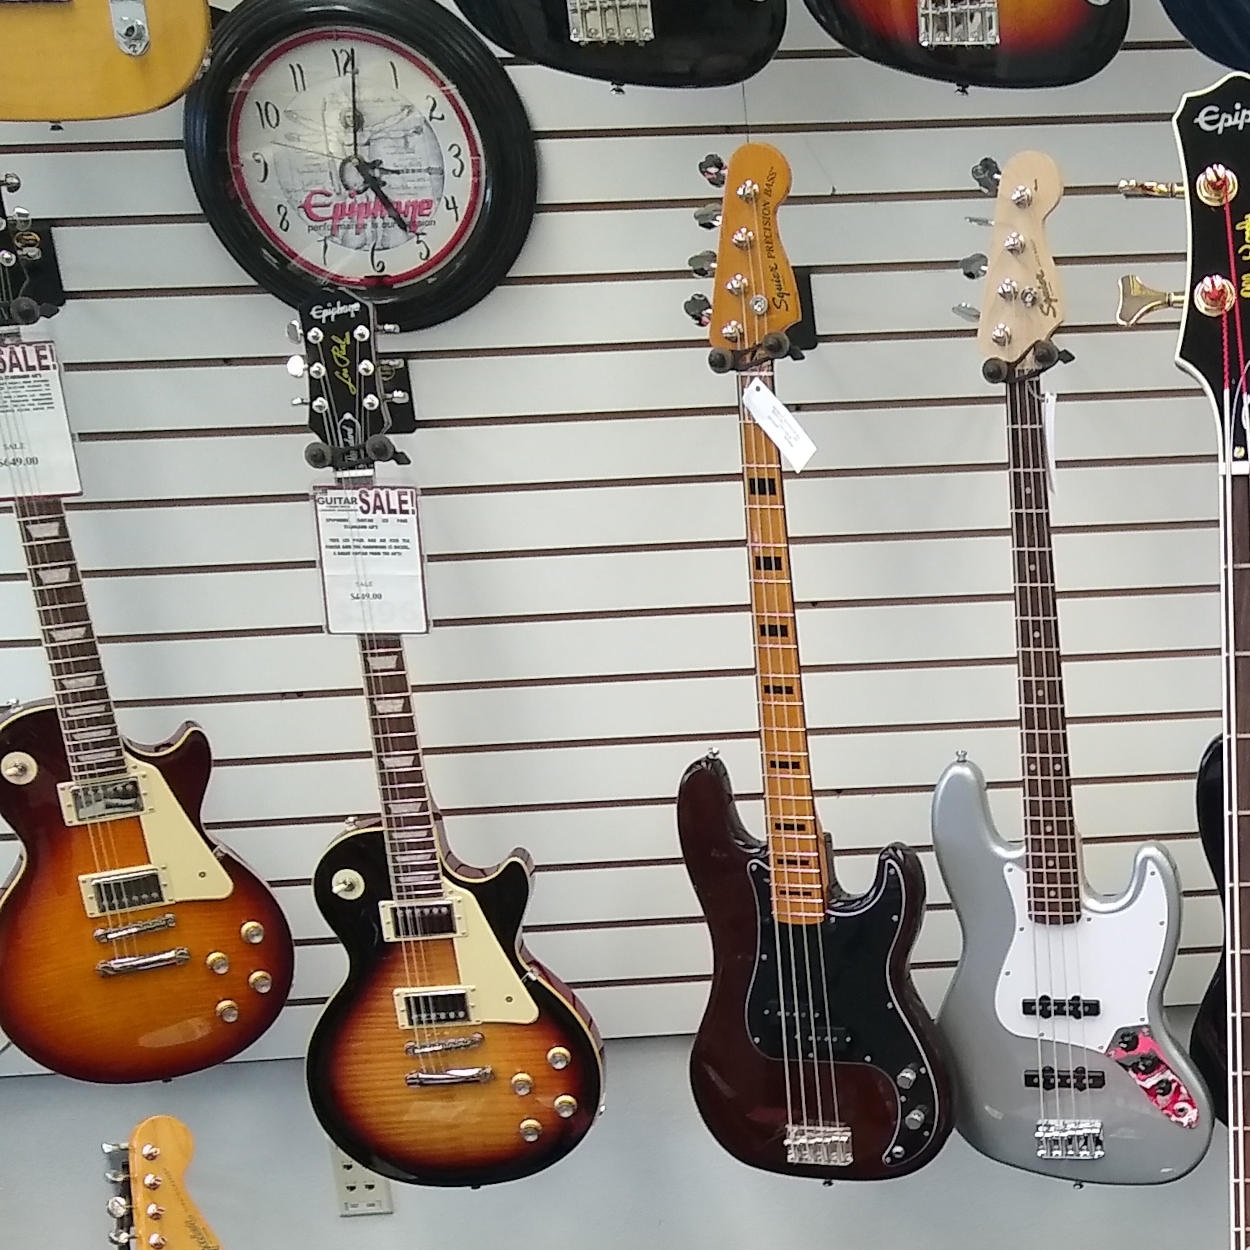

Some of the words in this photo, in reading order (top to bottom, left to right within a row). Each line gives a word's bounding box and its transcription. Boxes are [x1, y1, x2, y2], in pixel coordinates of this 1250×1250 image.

[289, 63, 306, 92] 11
[389, 61, 399, 90] 1
[255, 100, 280, 129] 10
[426, 94, 445, 121] 2
[252, 151, 269, 183] 9
[448, 143, 465, 178] 3
[763, 168, 777, 198] BASS
[277, 204, 289, 232] 8
[445, 196, 459, 222] 4
[761, 201, 776, 260] PRECISION
[317, 235, 330, 266] 7
[370, 242, 385, 273] 6
[415, 232, 431, 261] 5
[769, 262, 791, 312] Squier
[309, 301, 361, 324] Epiphone
[0, 344, 57, 374] SALE!
[317, 496, 358, 506] GUITAR
[358, 490, 416, 515] SALE!
